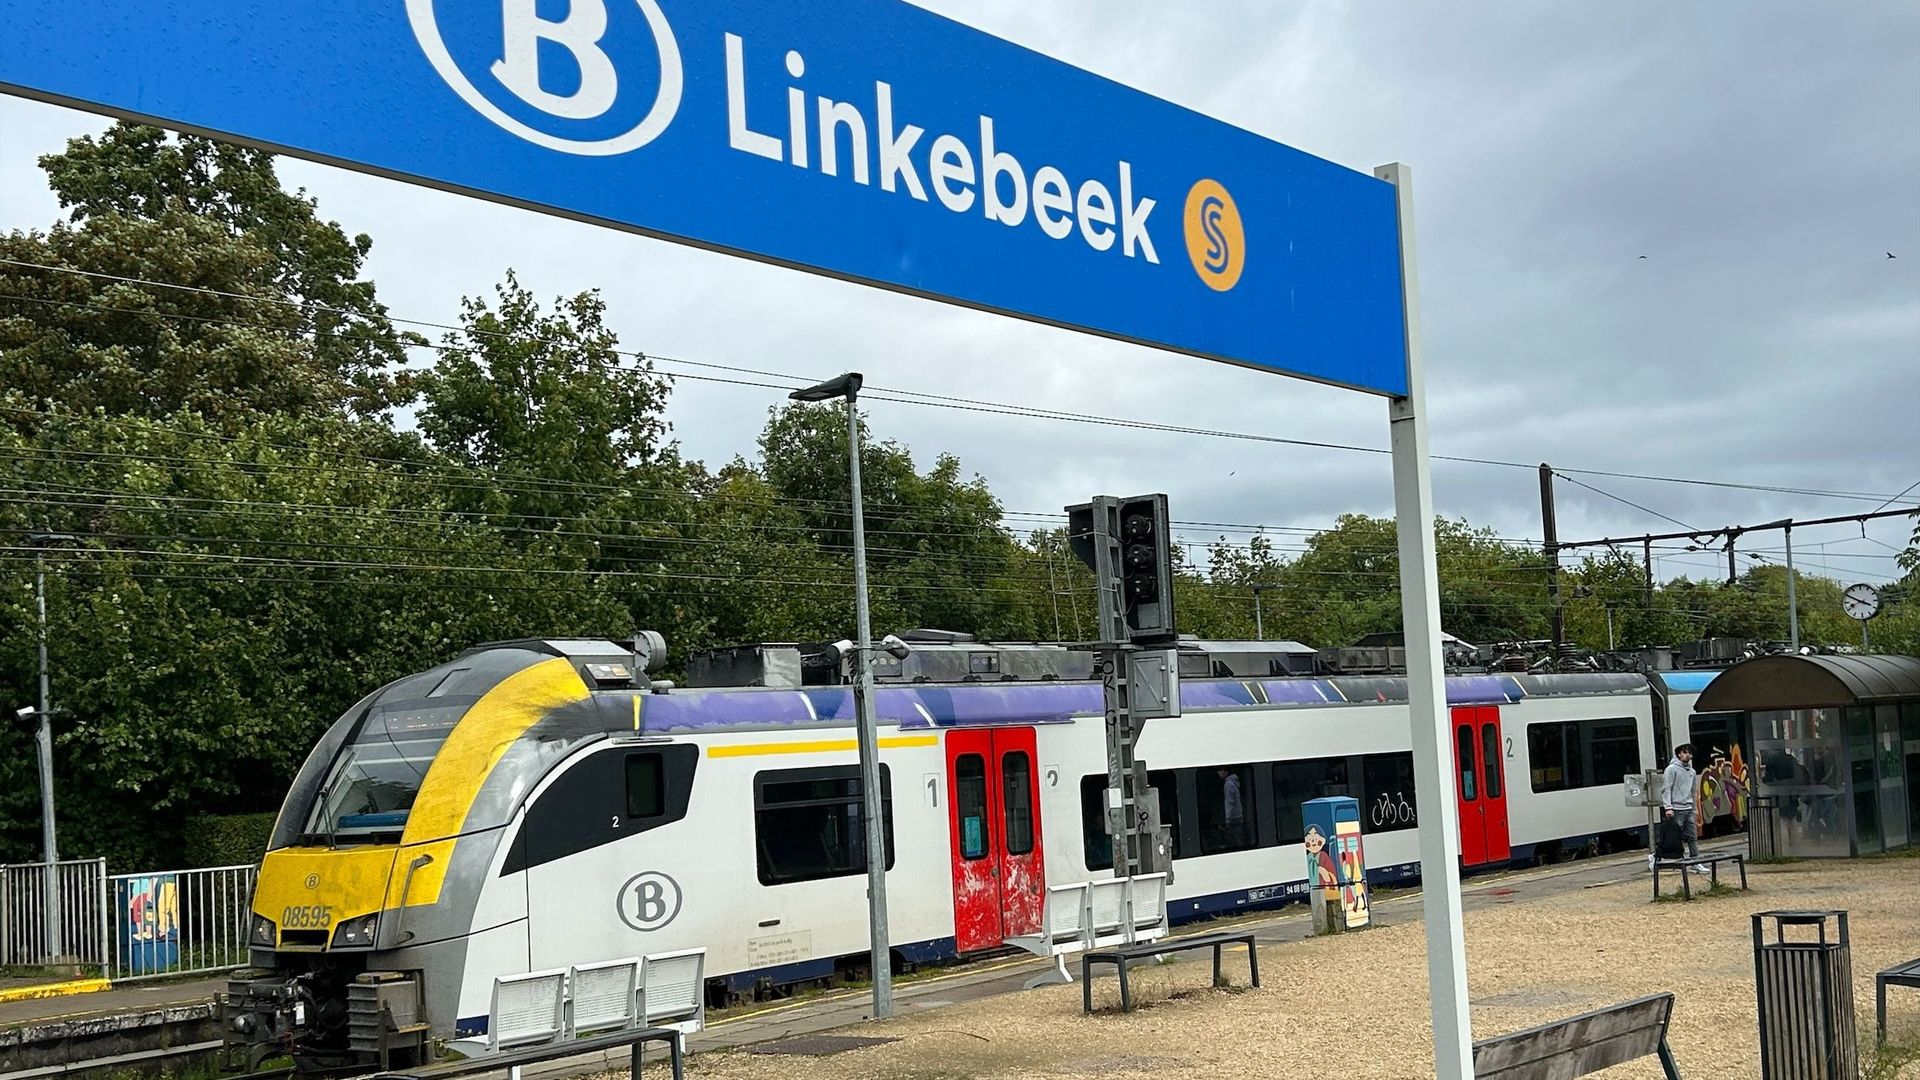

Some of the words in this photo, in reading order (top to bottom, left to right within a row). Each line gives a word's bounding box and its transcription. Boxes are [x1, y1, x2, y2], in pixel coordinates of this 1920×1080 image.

[490, 0, 618, 119] B
[725, 33, 1160, 264] Linkebeek
[1201, 196, 1229, 274] S
[1506, 737, 1514, 757] 2
[927, 778, 938, 808] 1
[612, 815, 620, 828] 2
[634, 880, 666, 922] B
[1286, 885, 1294, 895] 94
[282, 905, 333, 928] 08595
